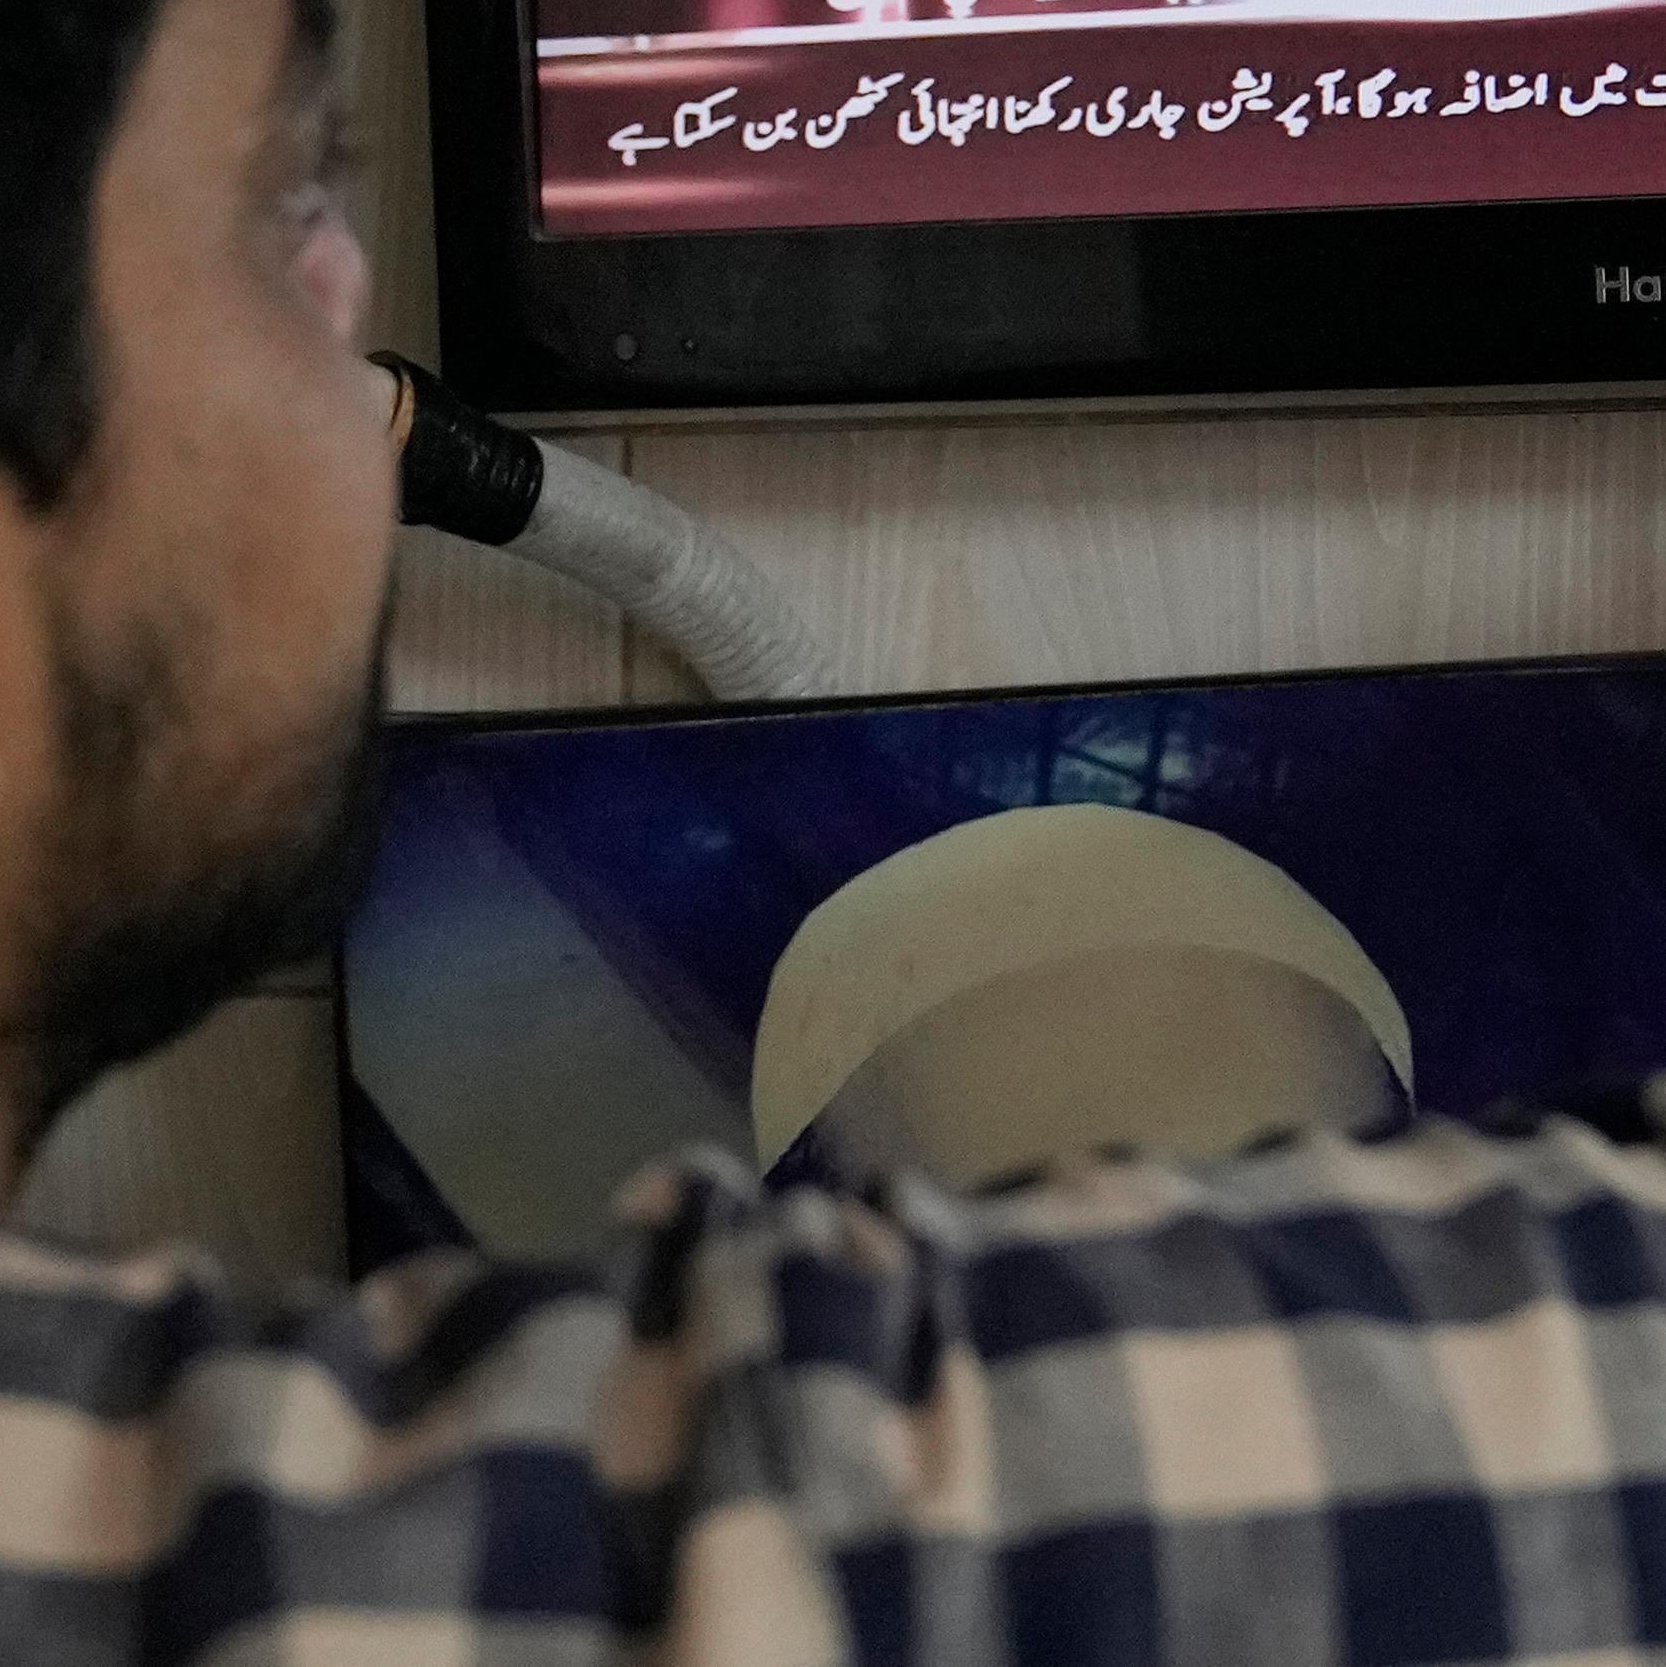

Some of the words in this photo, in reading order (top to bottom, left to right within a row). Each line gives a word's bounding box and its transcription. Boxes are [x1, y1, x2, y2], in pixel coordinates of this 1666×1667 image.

[897, 78, 1000, 147] انتہائی
[1004, 76, 1083, 134] رکھنا
[1085, 85, 1186, 140] جاری
[1439, 70, 1549, 116] اضافہ
[1559, 63, 1629, 117] میں
[608, 123, 670, 166] ہے
[673, 87, 738, 148] سکتا
[742, 108, 798, 151] بن
